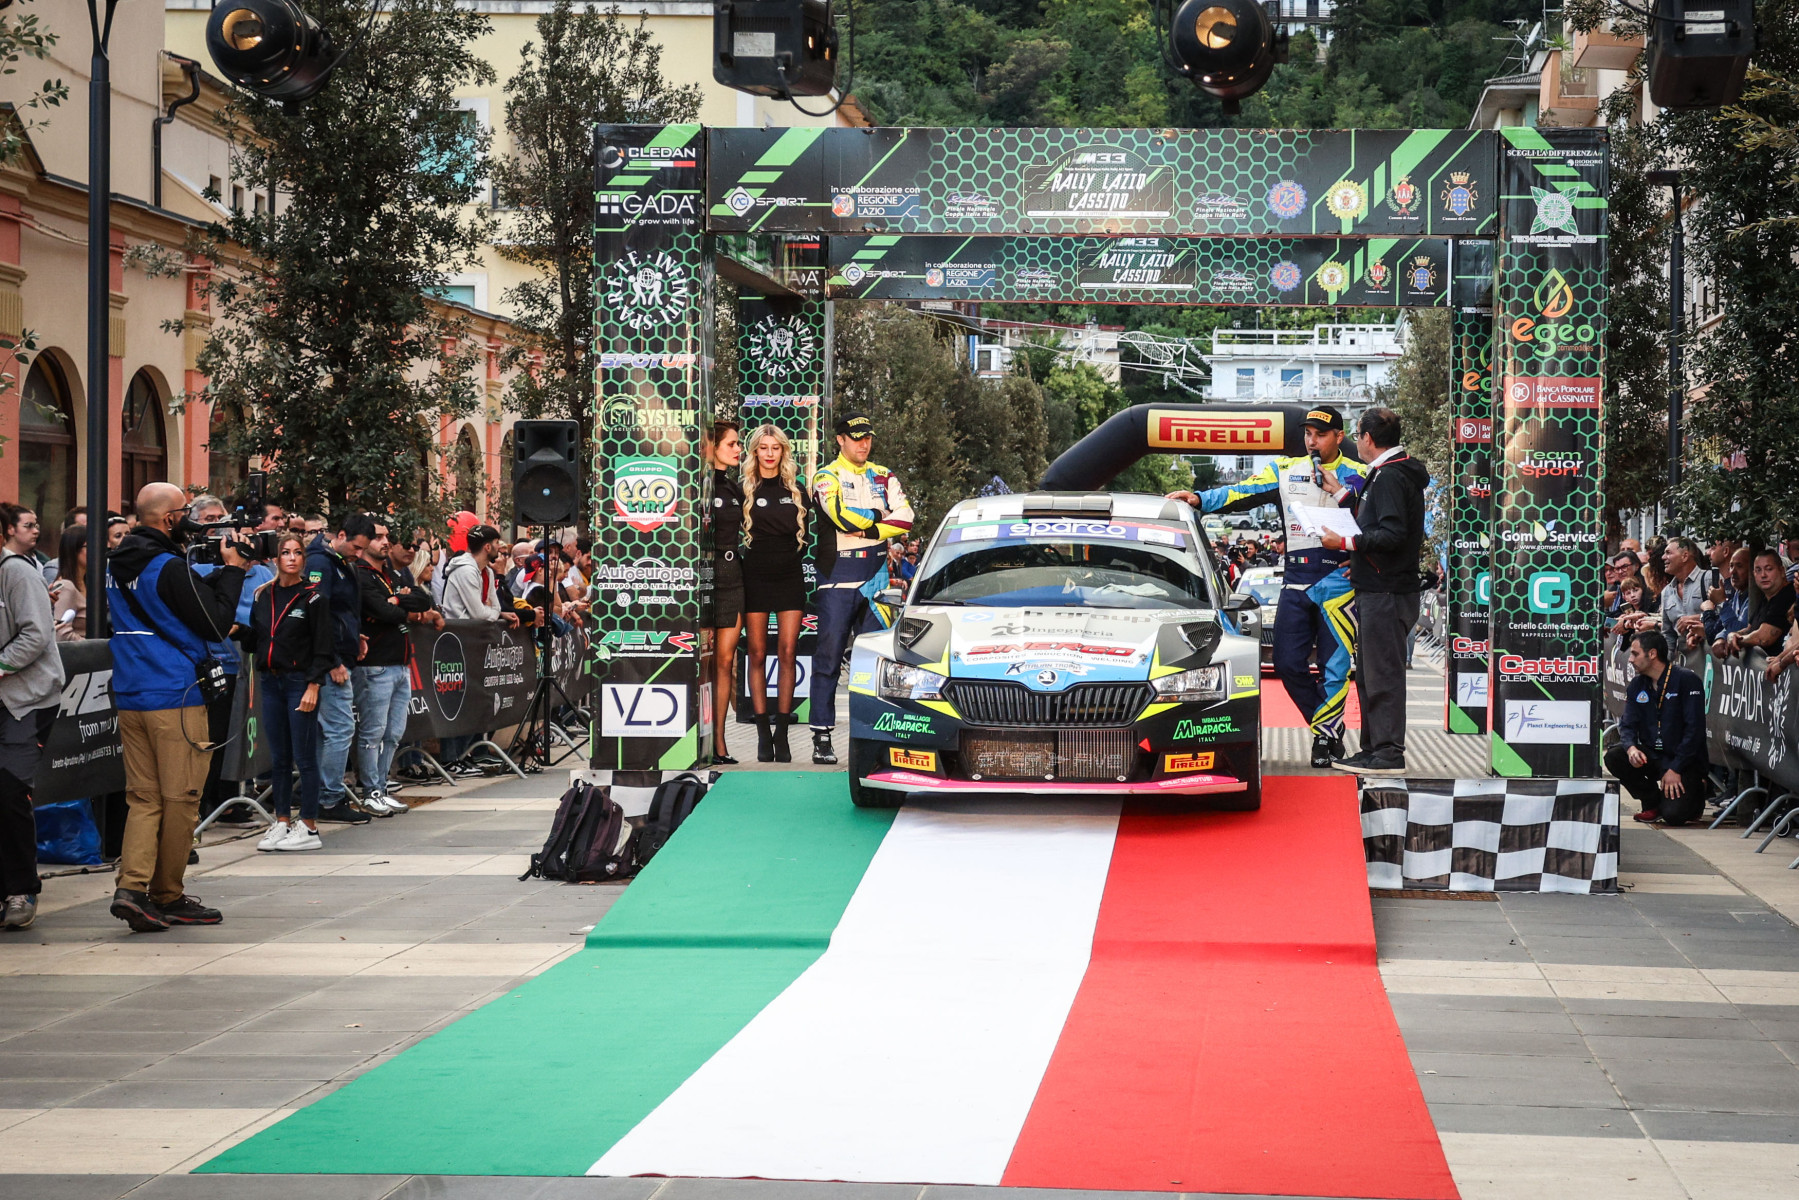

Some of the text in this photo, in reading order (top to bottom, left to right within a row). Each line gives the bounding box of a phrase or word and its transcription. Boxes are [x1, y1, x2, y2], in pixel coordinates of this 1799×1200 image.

[628, 147, 696, 158] CLEDAN
[1051, 173, 1147, 192] RALLY LAZIO
[840, 186, 903, 194] collaborazione
[622, 194, 695, 214] GADA
[755, 197, 808, 207] SPORT
[857, 196, 898, 205] REGIONE
[1068, 192, 1130, 211] CASSINO
[857, 207, 886, 215] LAZIO
[682, 218, 695, 226] life
[1099, 254, 1175, 269] RALLY LAZIO
[1112, 269, 1162, 284] CASSINO
[1511, 317, 1595, 357] egeo
[597, 353, 697, 368] SPOTUP
[743, 395, 820, 407] SPOTUP
[637, 409, 695, 425] SYSTEM
[1158, 417, 1273, 443] PIRELLI
[1520, 449, 1582, 460] Team
[1517, 455, 1584, 469] Junior
[1522, 464, 1580, 478] Sport
[1469, 475, 1489, 484] Te
[616, 478, 676, 507] ECO
[627, 500, 665, 513] LIRI
[1009, 522, 1126, 537] sparco
[1501, 530, 1597, 543] Gom Service
[1454, 539, 1480, 549] Gom
[597, 563, 694, 583] Autoeuropa
[638, 596, 677, 604] SKODA
[1508, 622, 1590, 631] Ceriello Conte Gerardo
[599, 631, 671, 644] AEV
[967, 641, 1137, 656] SINERGO
[966, 653, 1026, 662] COMPOSITES
[434, 660, 463, 673] Team
[1499, 655, 1598, 676] Cattini
[434, 668, 463, 684] Junior
[852, 673, 872, 684] OMP
[1234, 677, 1256, 687] OMP
[56, 669, 113, 719] AE
[436, 680, 463, 695] Sport
[1730, 665, 1765, 724] GADA
[610, 687, 679, 726] VLD
[1201, 716, 1232, 724] IMBALLAGGI
[1173, 719, 1233, 740] MIRAPACK
[893, 751, 930, 767] PIRELLI
[1170, 756, 1210, 769] PIRELLI
